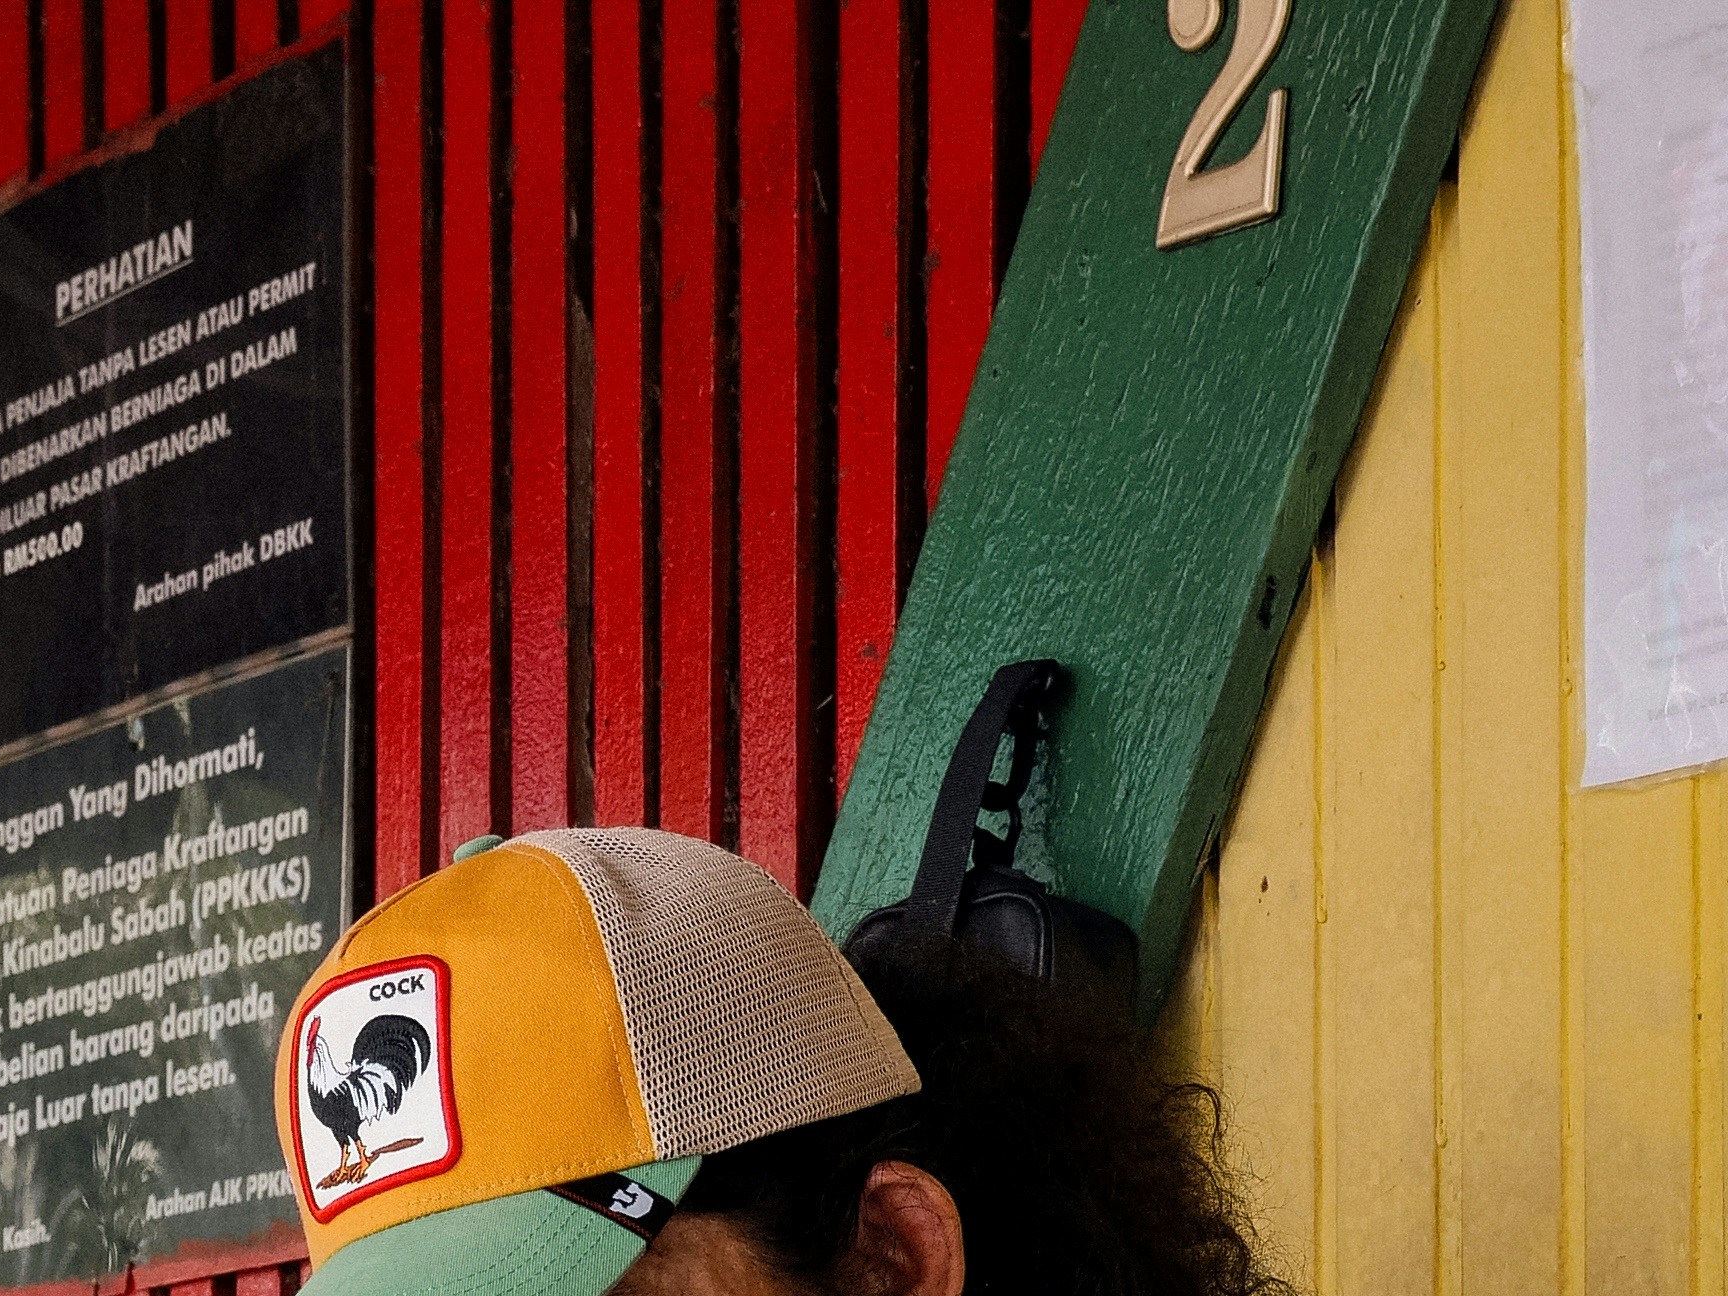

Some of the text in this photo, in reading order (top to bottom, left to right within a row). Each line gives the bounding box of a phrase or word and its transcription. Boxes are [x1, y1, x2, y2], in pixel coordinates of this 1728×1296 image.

[1156, 0, 1290, 249] 2
[56, 220, 192, 319] PERHATIAN
[6, 375, 74, 430] PENJAJA
[79, 347, 135, 394] TANPA
[139, 320, 192, 367] LESEN
[196, 295, 244, 341] ATAU
[248, 262, 316, 316] PERMIT
[0, 412, 107, 483] DIBENARKAN
[111, 370, 201, 433] BERNIAGA
[206, 358, 225, 390] DI
[230, 326, 297, 378] DALAM
[50, 466, 102, 512] PASAR
[106, 412, 232, 488] KRAFTANGAN.
[4, 521, 84, 575] RM500.00
[133, 517, 314, 613] Arahan pihak DBKK
[70, 775, 128, 824] Yang
[134, 726, 265, 800] Dihormati,
[62, 850, 157, 908] Peniaga
[163, 805, 308, 874] Kraftangan
[3, 913, 106, 980] Kinabalu
[111, 888, 185, 947] Sabah
[192, 855, 311, 928] (PPKKKS)
[7, 940, 228, 1043] bertanggungjawab
[235, 918, 322, 966] keatas
[70, 1017, 155, 1067] barang
[160, 987, 274, 1048] daripada
[368, 973, 426, 1002] COCK
[36, 1091, 85, 1132] Luar
[91, 1074, 158, 1119] tanpa
[166, 1055, 236, 1100] lesen.
[145, 1187, 206, 1221] Arahan
[208, 1176, 243, 1208] AJK
